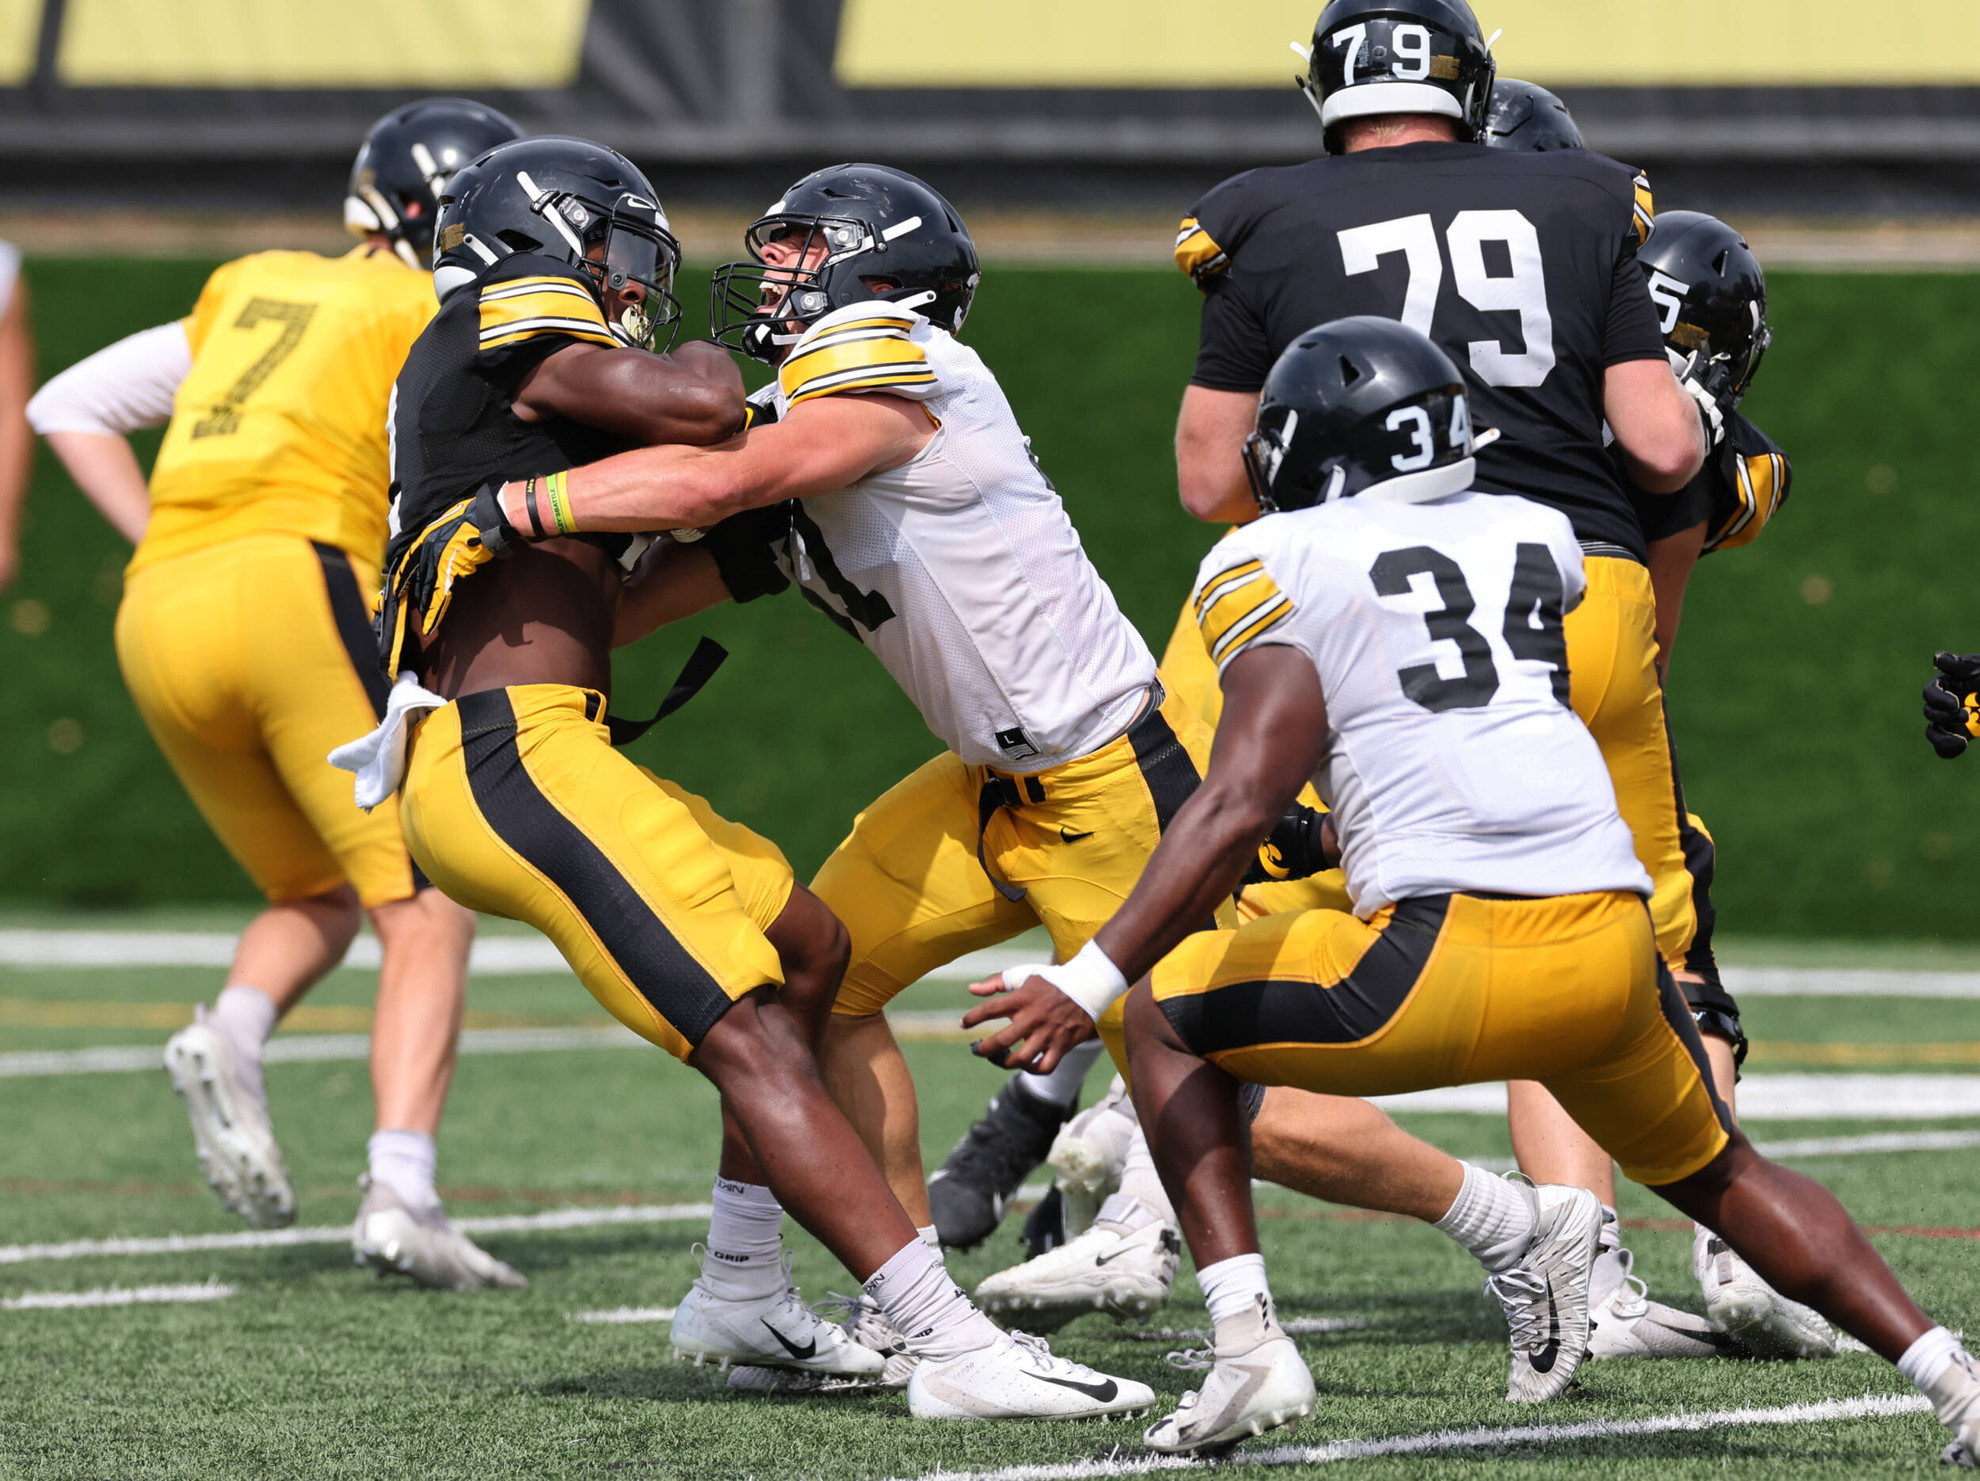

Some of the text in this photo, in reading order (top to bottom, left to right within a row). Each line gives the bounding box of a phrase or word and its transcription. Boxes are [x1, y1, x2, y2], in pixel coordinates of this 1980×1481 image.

[1332, 23, 1431, 87] 79
[1336, 209, 1556, 387] 79
[192, 296, 319, 440] 7
[1385, 393, 1473, 472] 34
[1369, 541, 1573, 713] 34
[714, 1251, 750, 1263] GRIP
